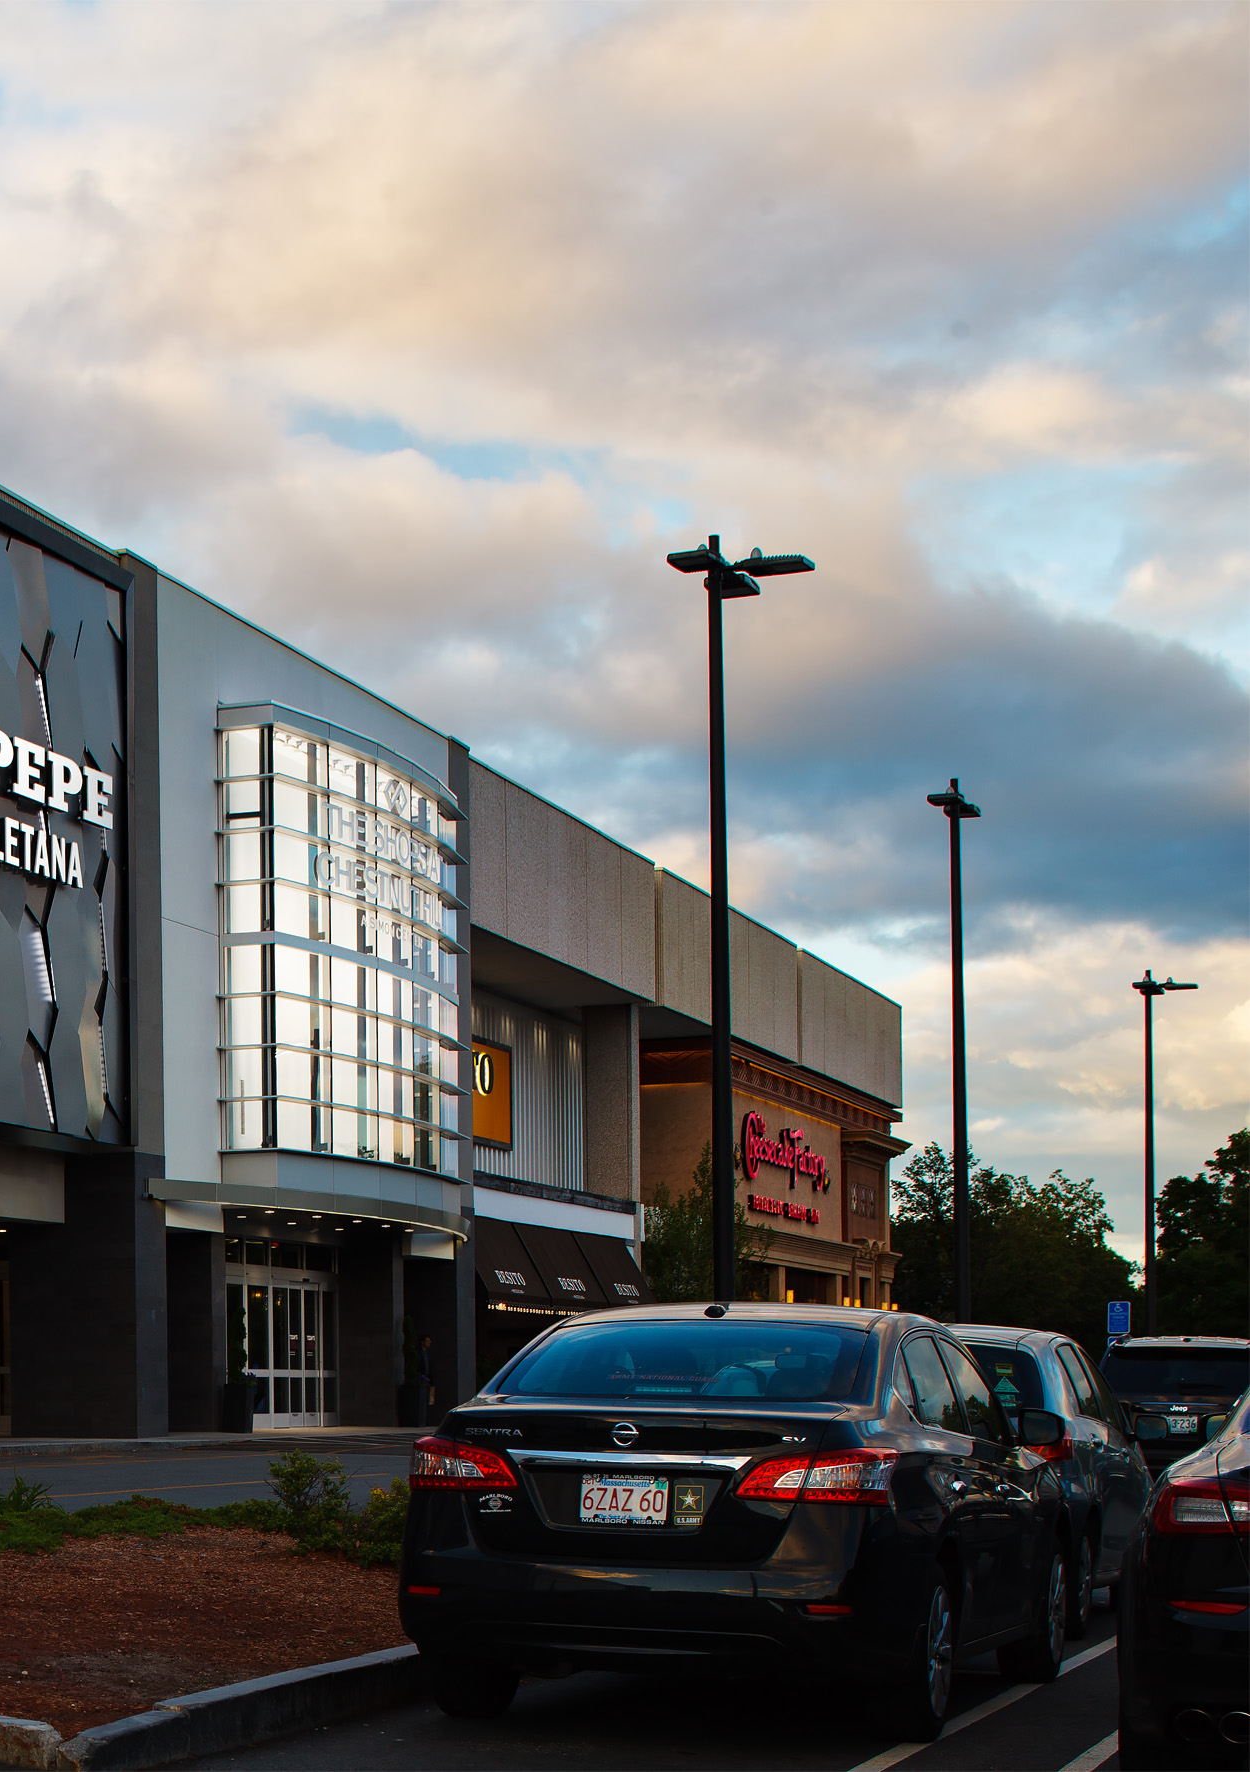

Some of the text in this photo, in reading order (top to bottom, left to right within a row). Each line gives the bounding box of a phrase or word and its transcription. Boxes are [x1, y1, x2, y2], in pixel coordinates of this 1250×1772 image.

[323, 802, 369, 847] THE
[372, 820, 427, 876] SHOPS
[316, 851, 419, 918] CHESTNUT
[745, 1111, 826, 1191] Cheesecake Factory
[494, 1269, 526, 1286] BESITO
[557, 1277, 587, 1292] BESITO
[613, 1283, 640, 1297] BESITO
[639, 1374, 686, 1382] NATIONAL
[1169, 1404, 1189, 1412] Jeep
[464, 1427, 524, 1438] SENTRA
[781, 1436, 807, 1444] SV
[599, 1478, 651, 1487] Massachusetts
[479, 1493, 513, 1503] MARLBORO
[582, 1487, 665, 1513] 6ZAZ 60
[581, 1517, 628, 1525] MARLBORO
